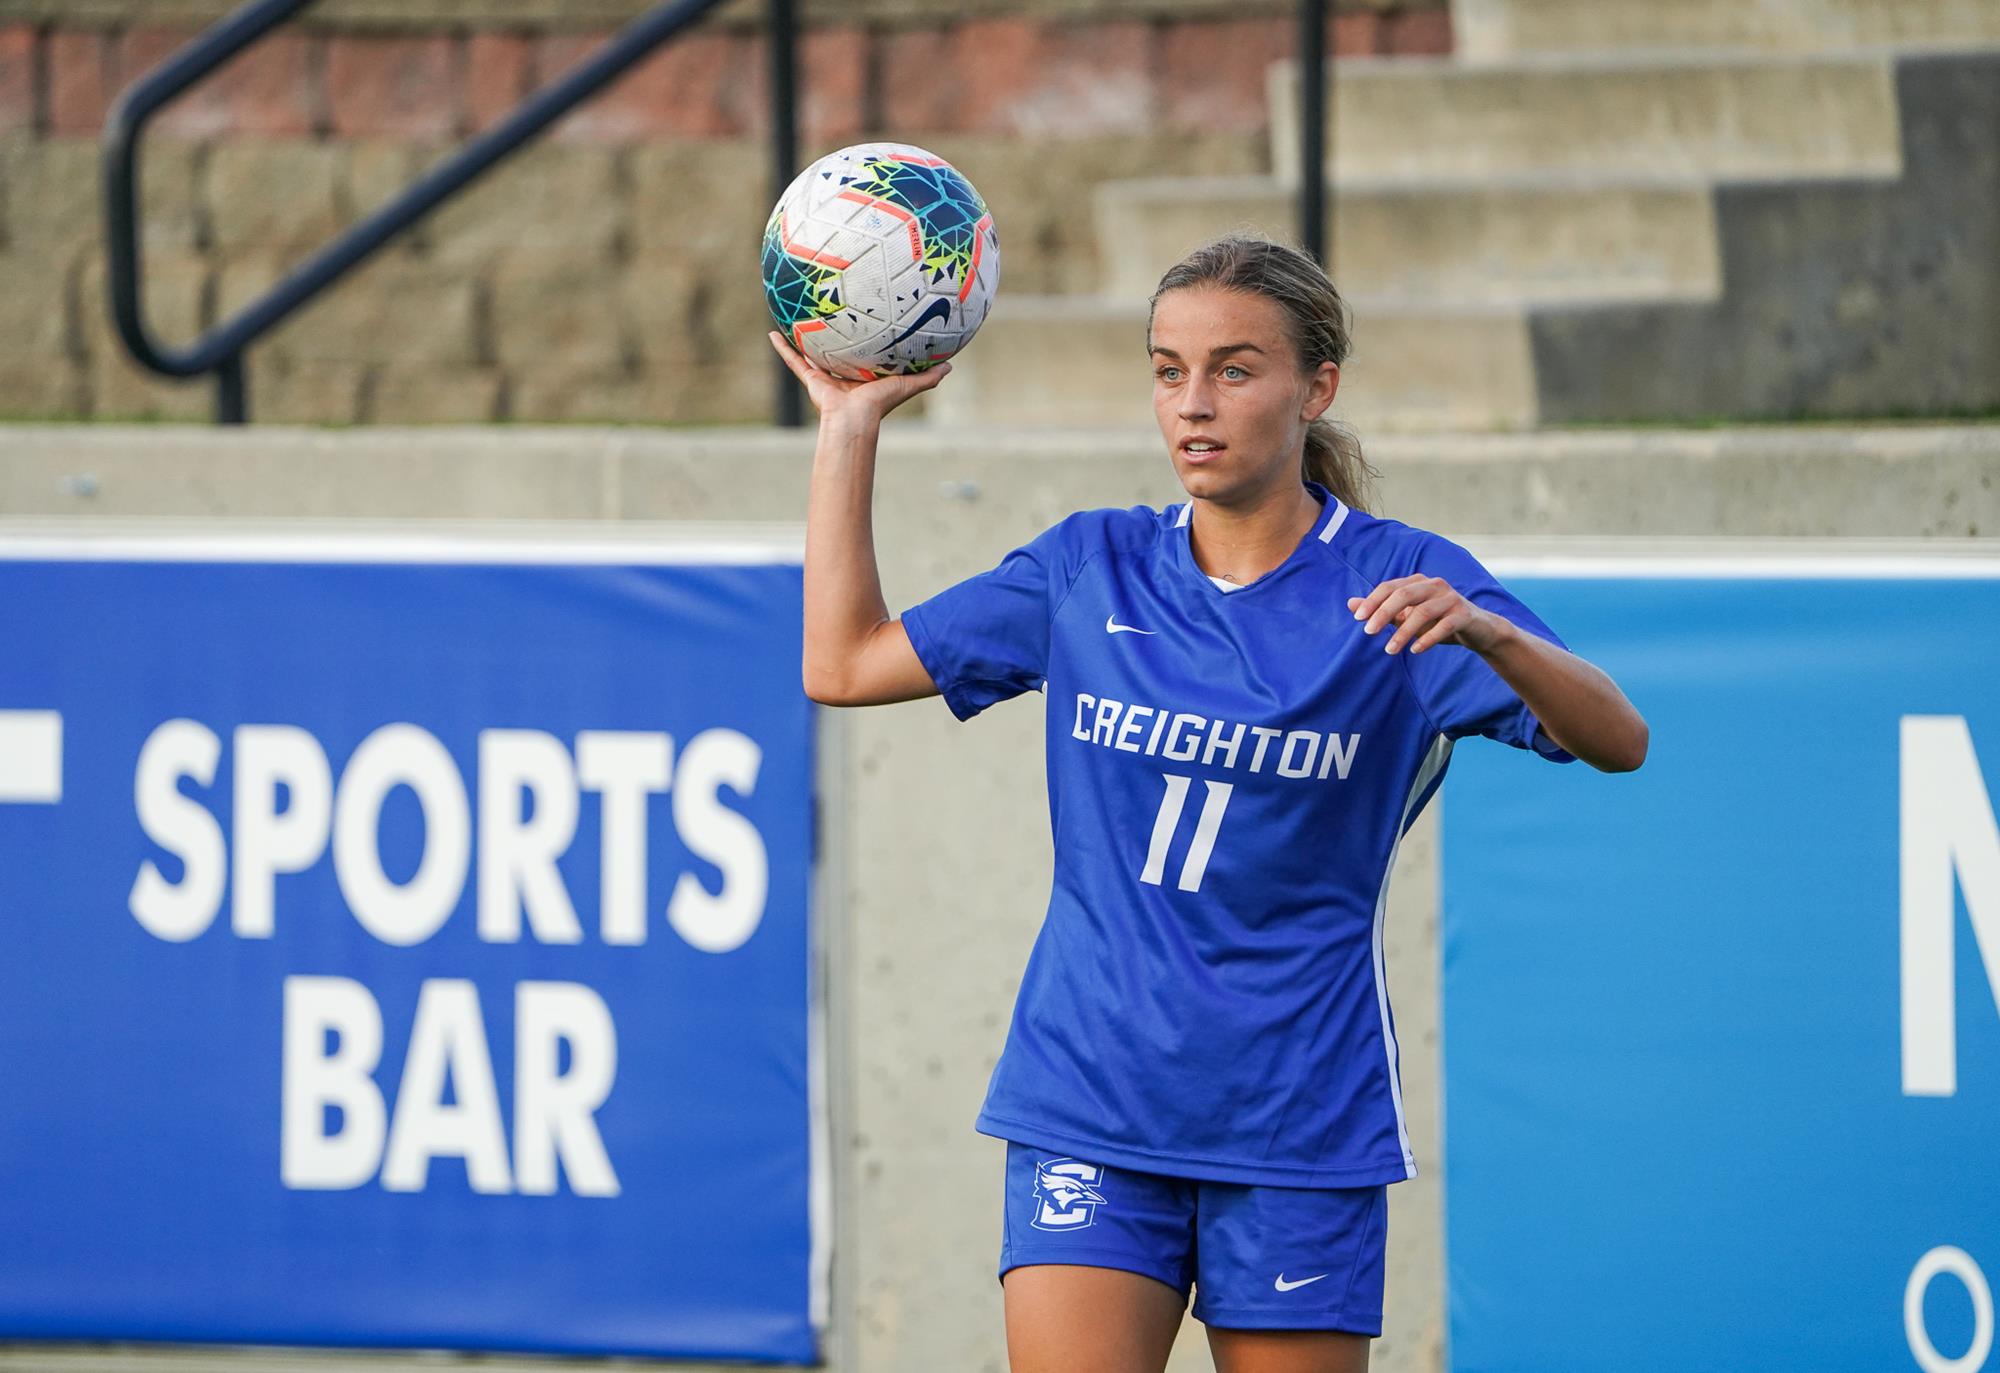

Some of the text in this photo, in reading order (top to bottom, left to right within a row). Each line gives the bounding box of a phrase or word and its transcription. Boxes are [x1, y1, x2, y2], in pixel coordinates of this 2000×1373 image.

[911, 226, 922, 257] MERLIN
[1071, 693, 1361, 780] CREIGHTON
[128, 717, 770, 954] SPORTS
[1139, 773, 1234, 893] 11
[280, 975, 623, 1198] BAR
